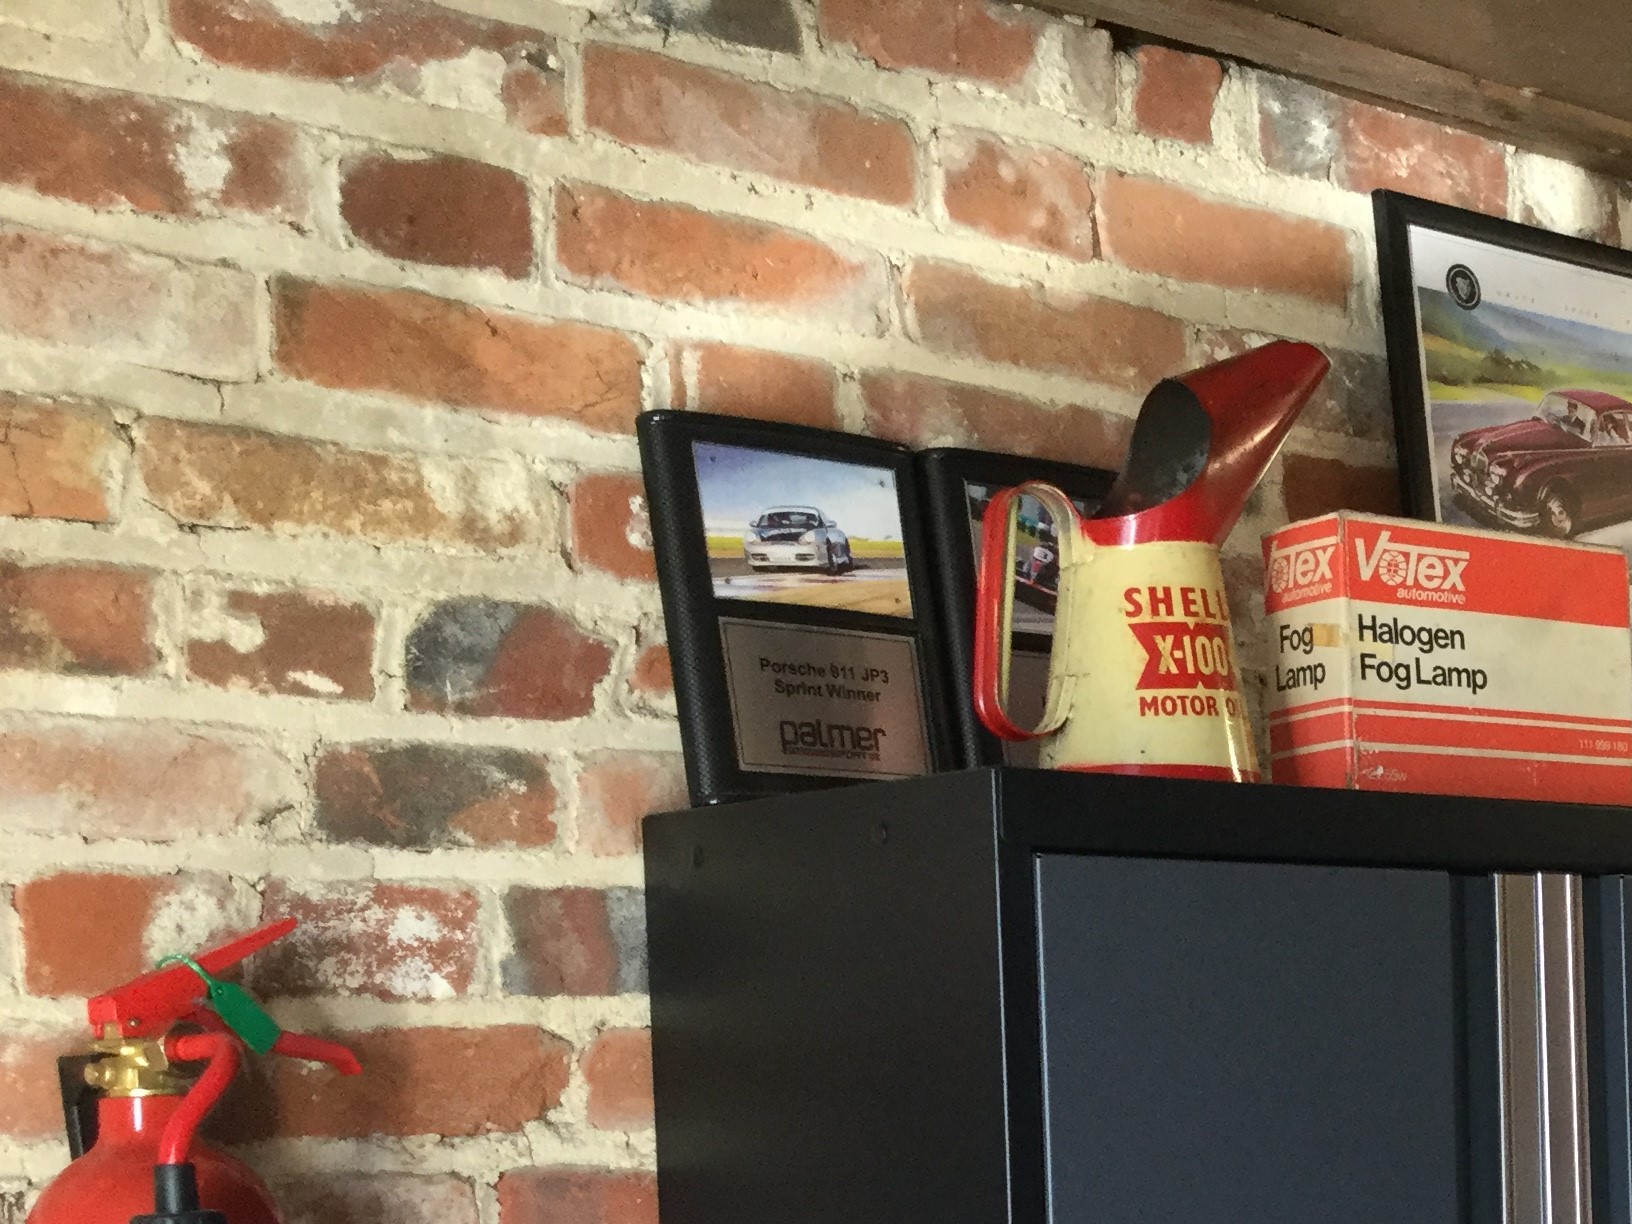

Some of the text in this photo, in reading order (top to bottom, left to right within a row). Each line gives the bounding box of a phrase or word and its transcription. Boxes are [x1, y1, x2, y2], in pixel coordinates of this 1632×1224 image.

[1124, 586, 1228, 621] SHELL
[1397, 587, 1466, 605] automotive
[1279, 624, 1314, 654] Fog
[1358, 613, 1466, 654] Halogen
[759, 657, 826, 678] Porsche
[862, 668, 889, 684] JP3
[1153, 635, 1229, 677] X-100
[1275, 662, 1326, 692] Lamp
[1360, 653, 1488, 695] Fog Lamp
[774, 679, 881, 702] Sprint Winner
[1139, 695, 1219, 717] MOTOR
[779, 719, 887, 755] palmer
